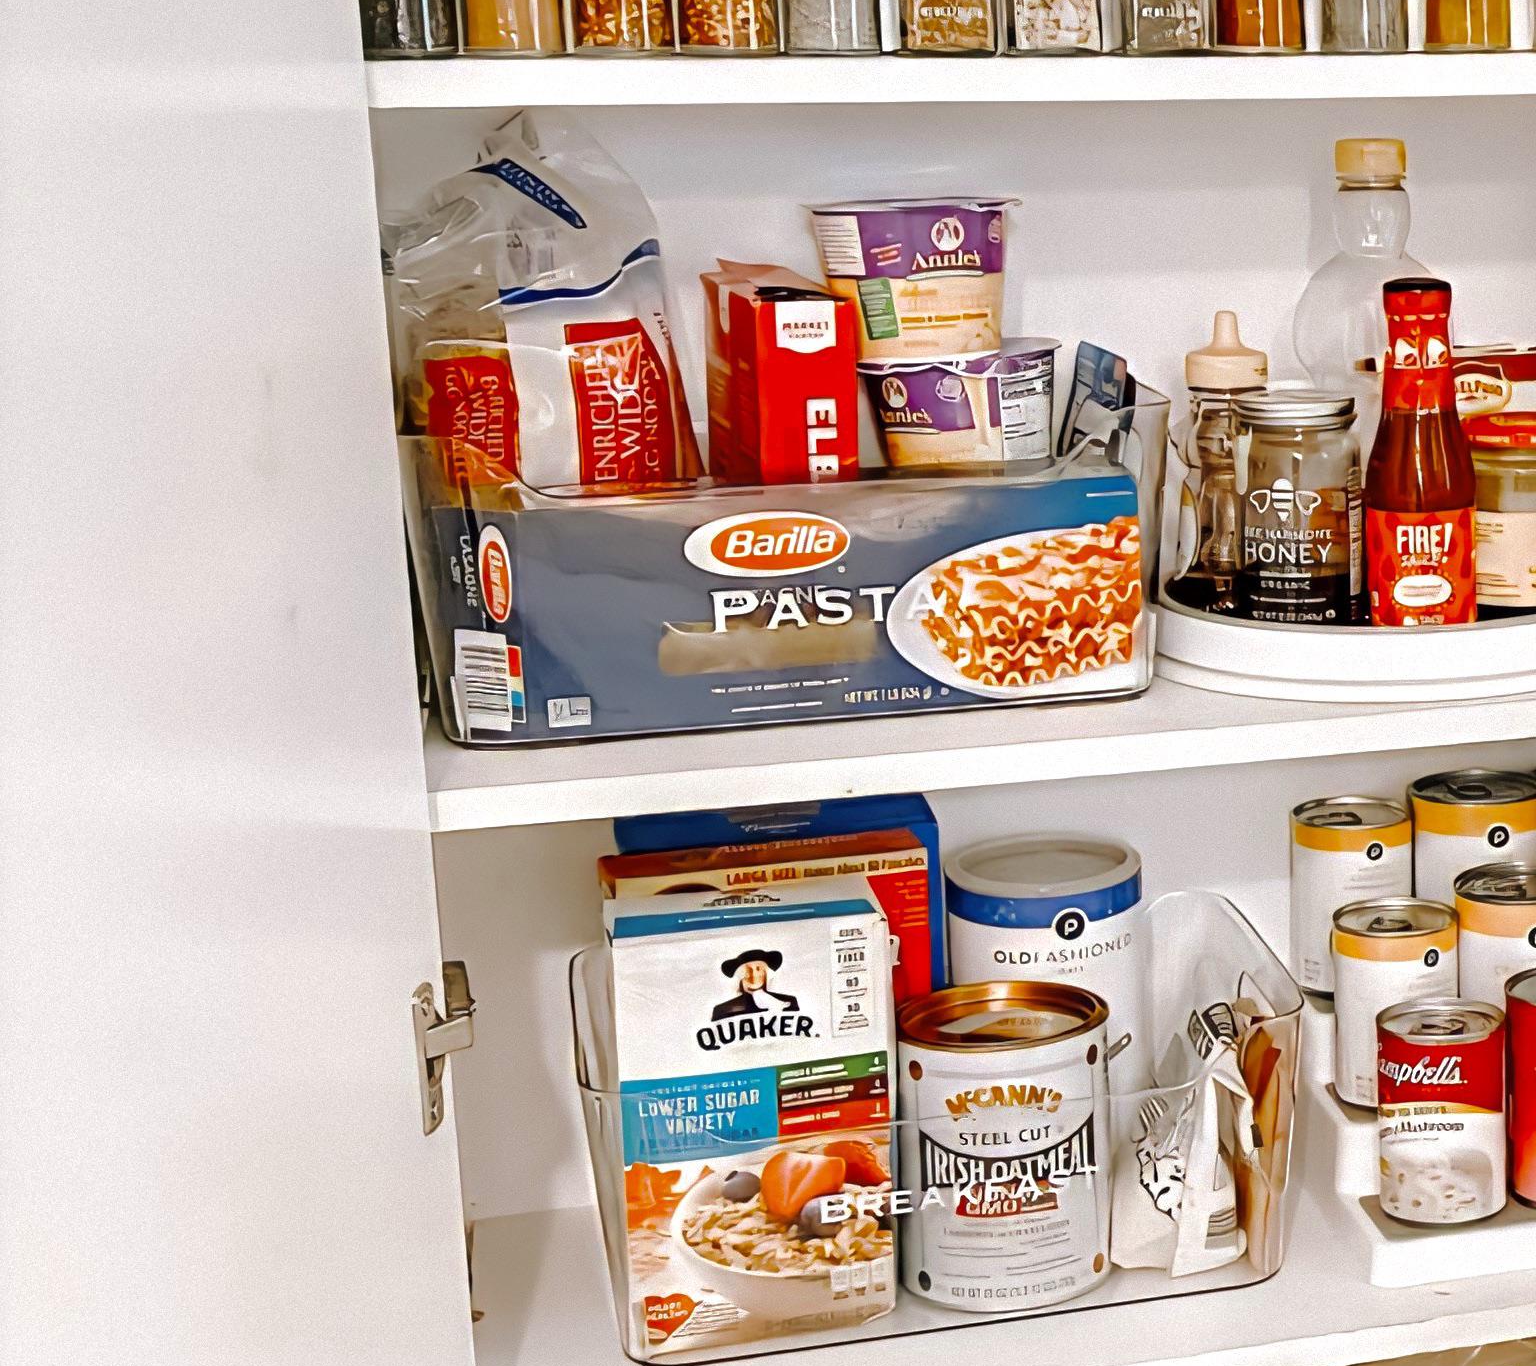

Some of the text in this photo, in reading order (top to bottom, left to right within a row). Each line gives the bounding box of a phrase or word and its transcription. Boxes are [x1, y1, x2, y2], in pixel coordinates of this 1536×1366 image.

[724, 525, 838, 559] Barilla
[1244, 541, 1332, 565] HONEY
[1396, 522, 1453, 564] FIRE!
[994, 950, 1032, 965] OLD
[696, 1015, 814, 1051] QUAKER
[638, 1088, 760, 1118] LOWER SUGAR
[665, 1110, 736, 1135] VARIETY
[959, 1124, 1052, 1147] STEEL CUT
[924, 1138, 989, 1186] IRISH
